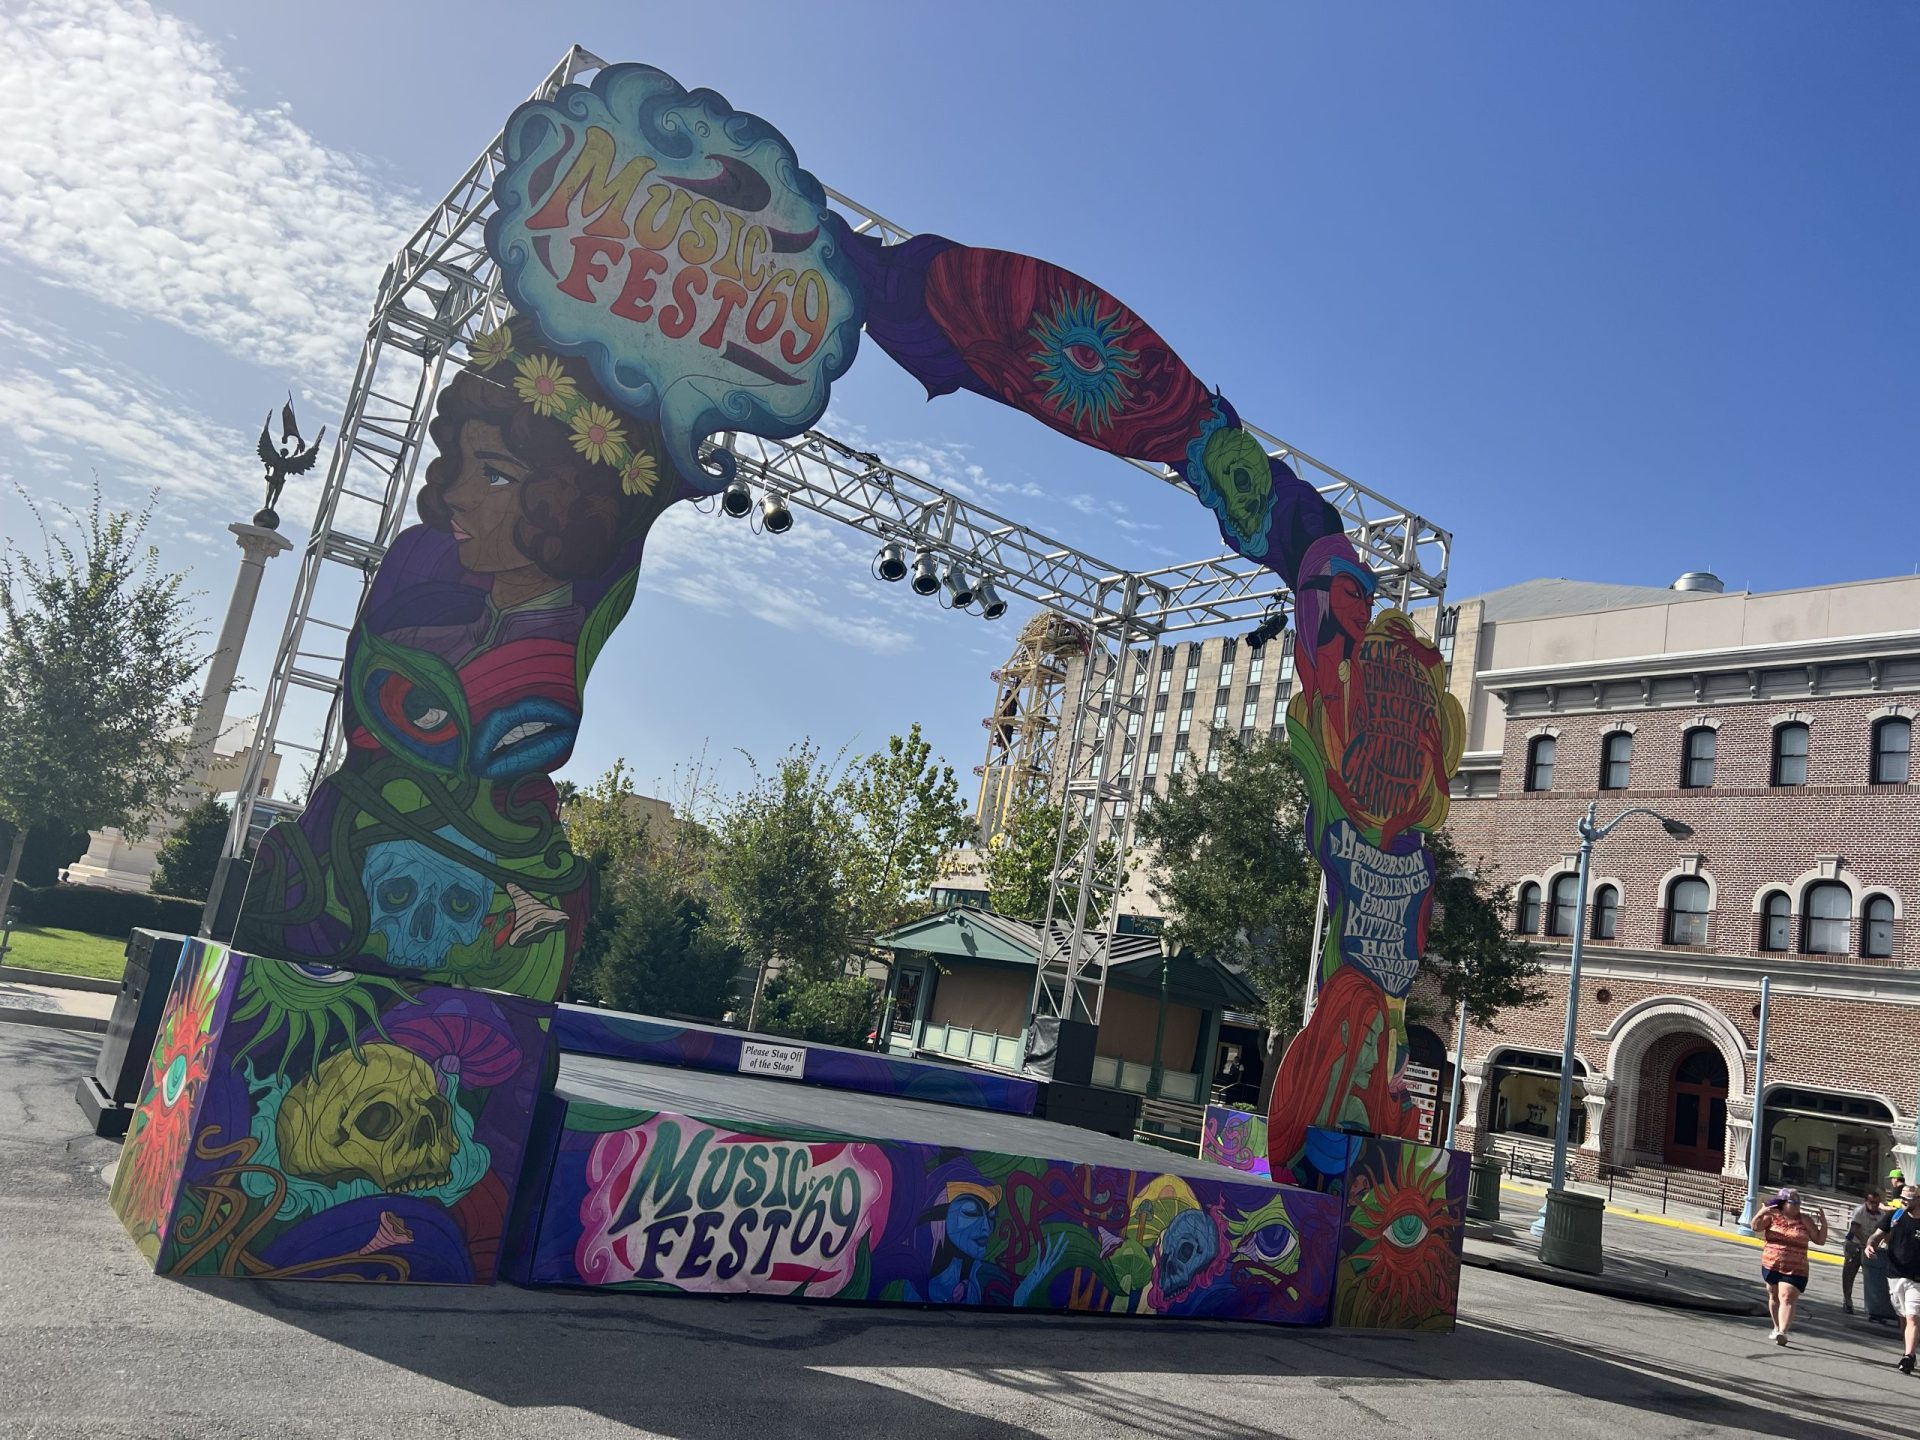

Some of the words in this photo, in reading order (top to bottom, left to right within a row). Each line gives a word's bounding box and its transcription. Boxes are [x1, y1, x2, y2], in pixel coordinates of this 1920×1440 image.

[525, 126, 767, 291] MUSIC
[557, 236, 748, 349] FEST
[1363, 661, 1436, 707] GEMSTONES
[1365, 691, 1436, 734] PACIFIC
[1342, 731, 1418, 819] CARROTS
[1363, 734, 1425, 781] FLAMING
[1337, 820, 1425, 876] HENDERSON
[1349, 860, 1430, 897] EXPERIENCE
[1344, 899, 1408, 941] KITTIES
[1360, 892, 1412, 926] GROOVY
[1347, 951, 1420, 979] DIAMOND
[1360, 939, 1408, 960] HAZY
[1369, 969, 1410, 994] TRIO
[746, 1045, 769, 1057] Please
[771, 1049, 788, 1061] Stay
[790, 1051, 803, 1063] Off
[750, 1058, 758, 1068] of
[758, 1059, 772, 1069] the
[772, 1061, 794, 1073] Stage
[607, 1120, 808, 1235] MUSIC
[633, 1208, 792, 1280] FEST
